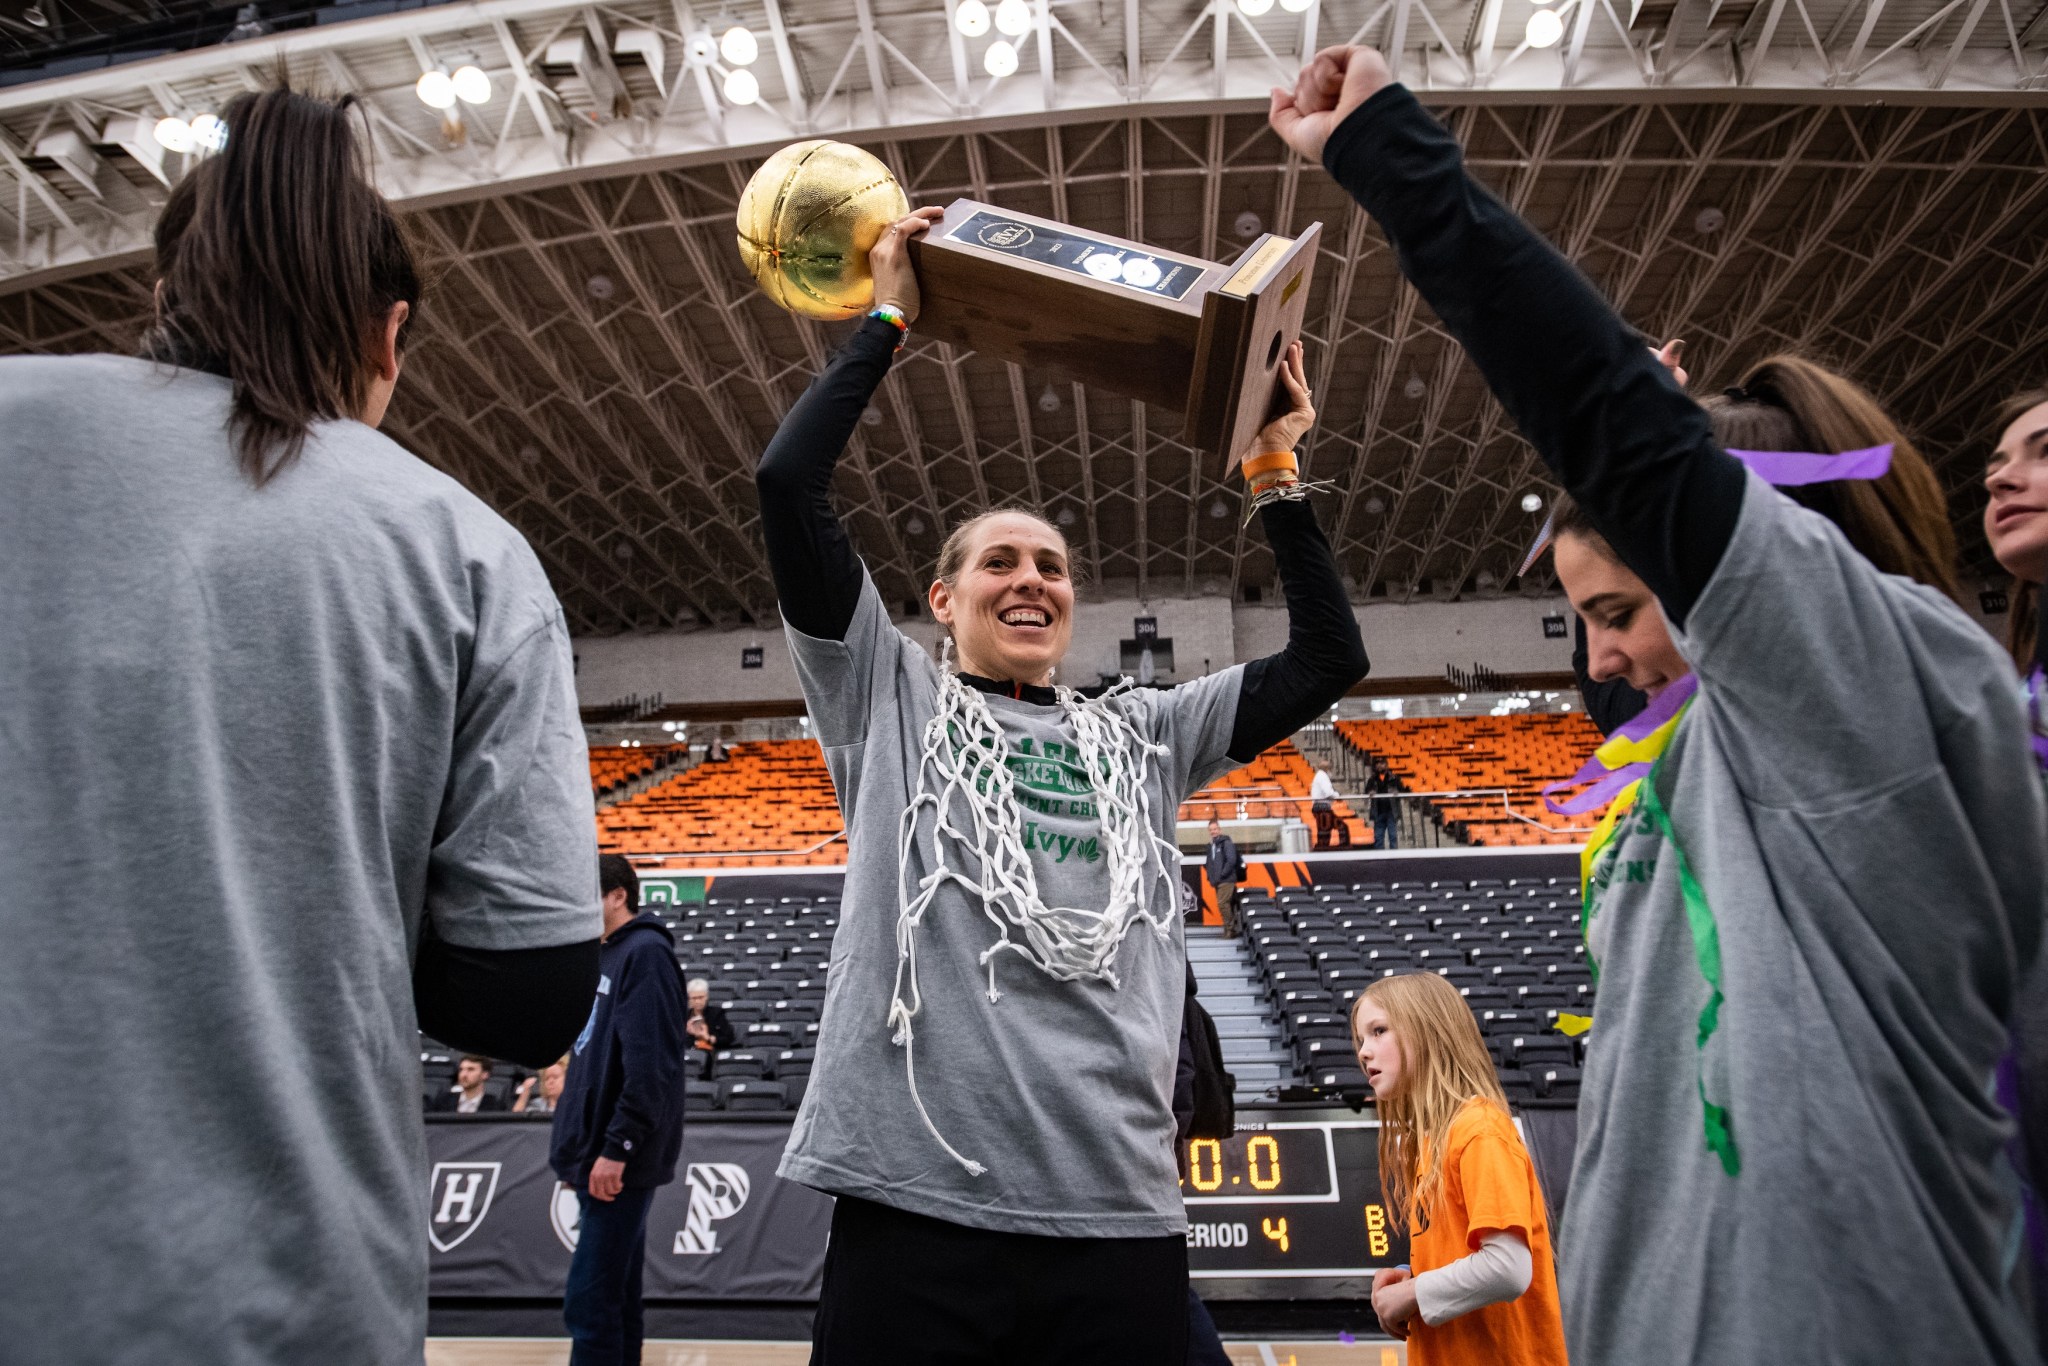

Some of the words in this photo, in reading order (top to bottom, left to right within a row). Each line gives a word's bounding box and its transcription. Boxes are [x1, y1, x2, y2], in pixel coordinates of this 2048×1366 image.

[1024, 822, 1077, 863] Ivy
[434, 1173, 483, 1223] H
[673, 1163, 750, 1254] P
[1187, 1222, 1249, 1248] ERIOD
[1261, 1216, 1290, 1253] 4
